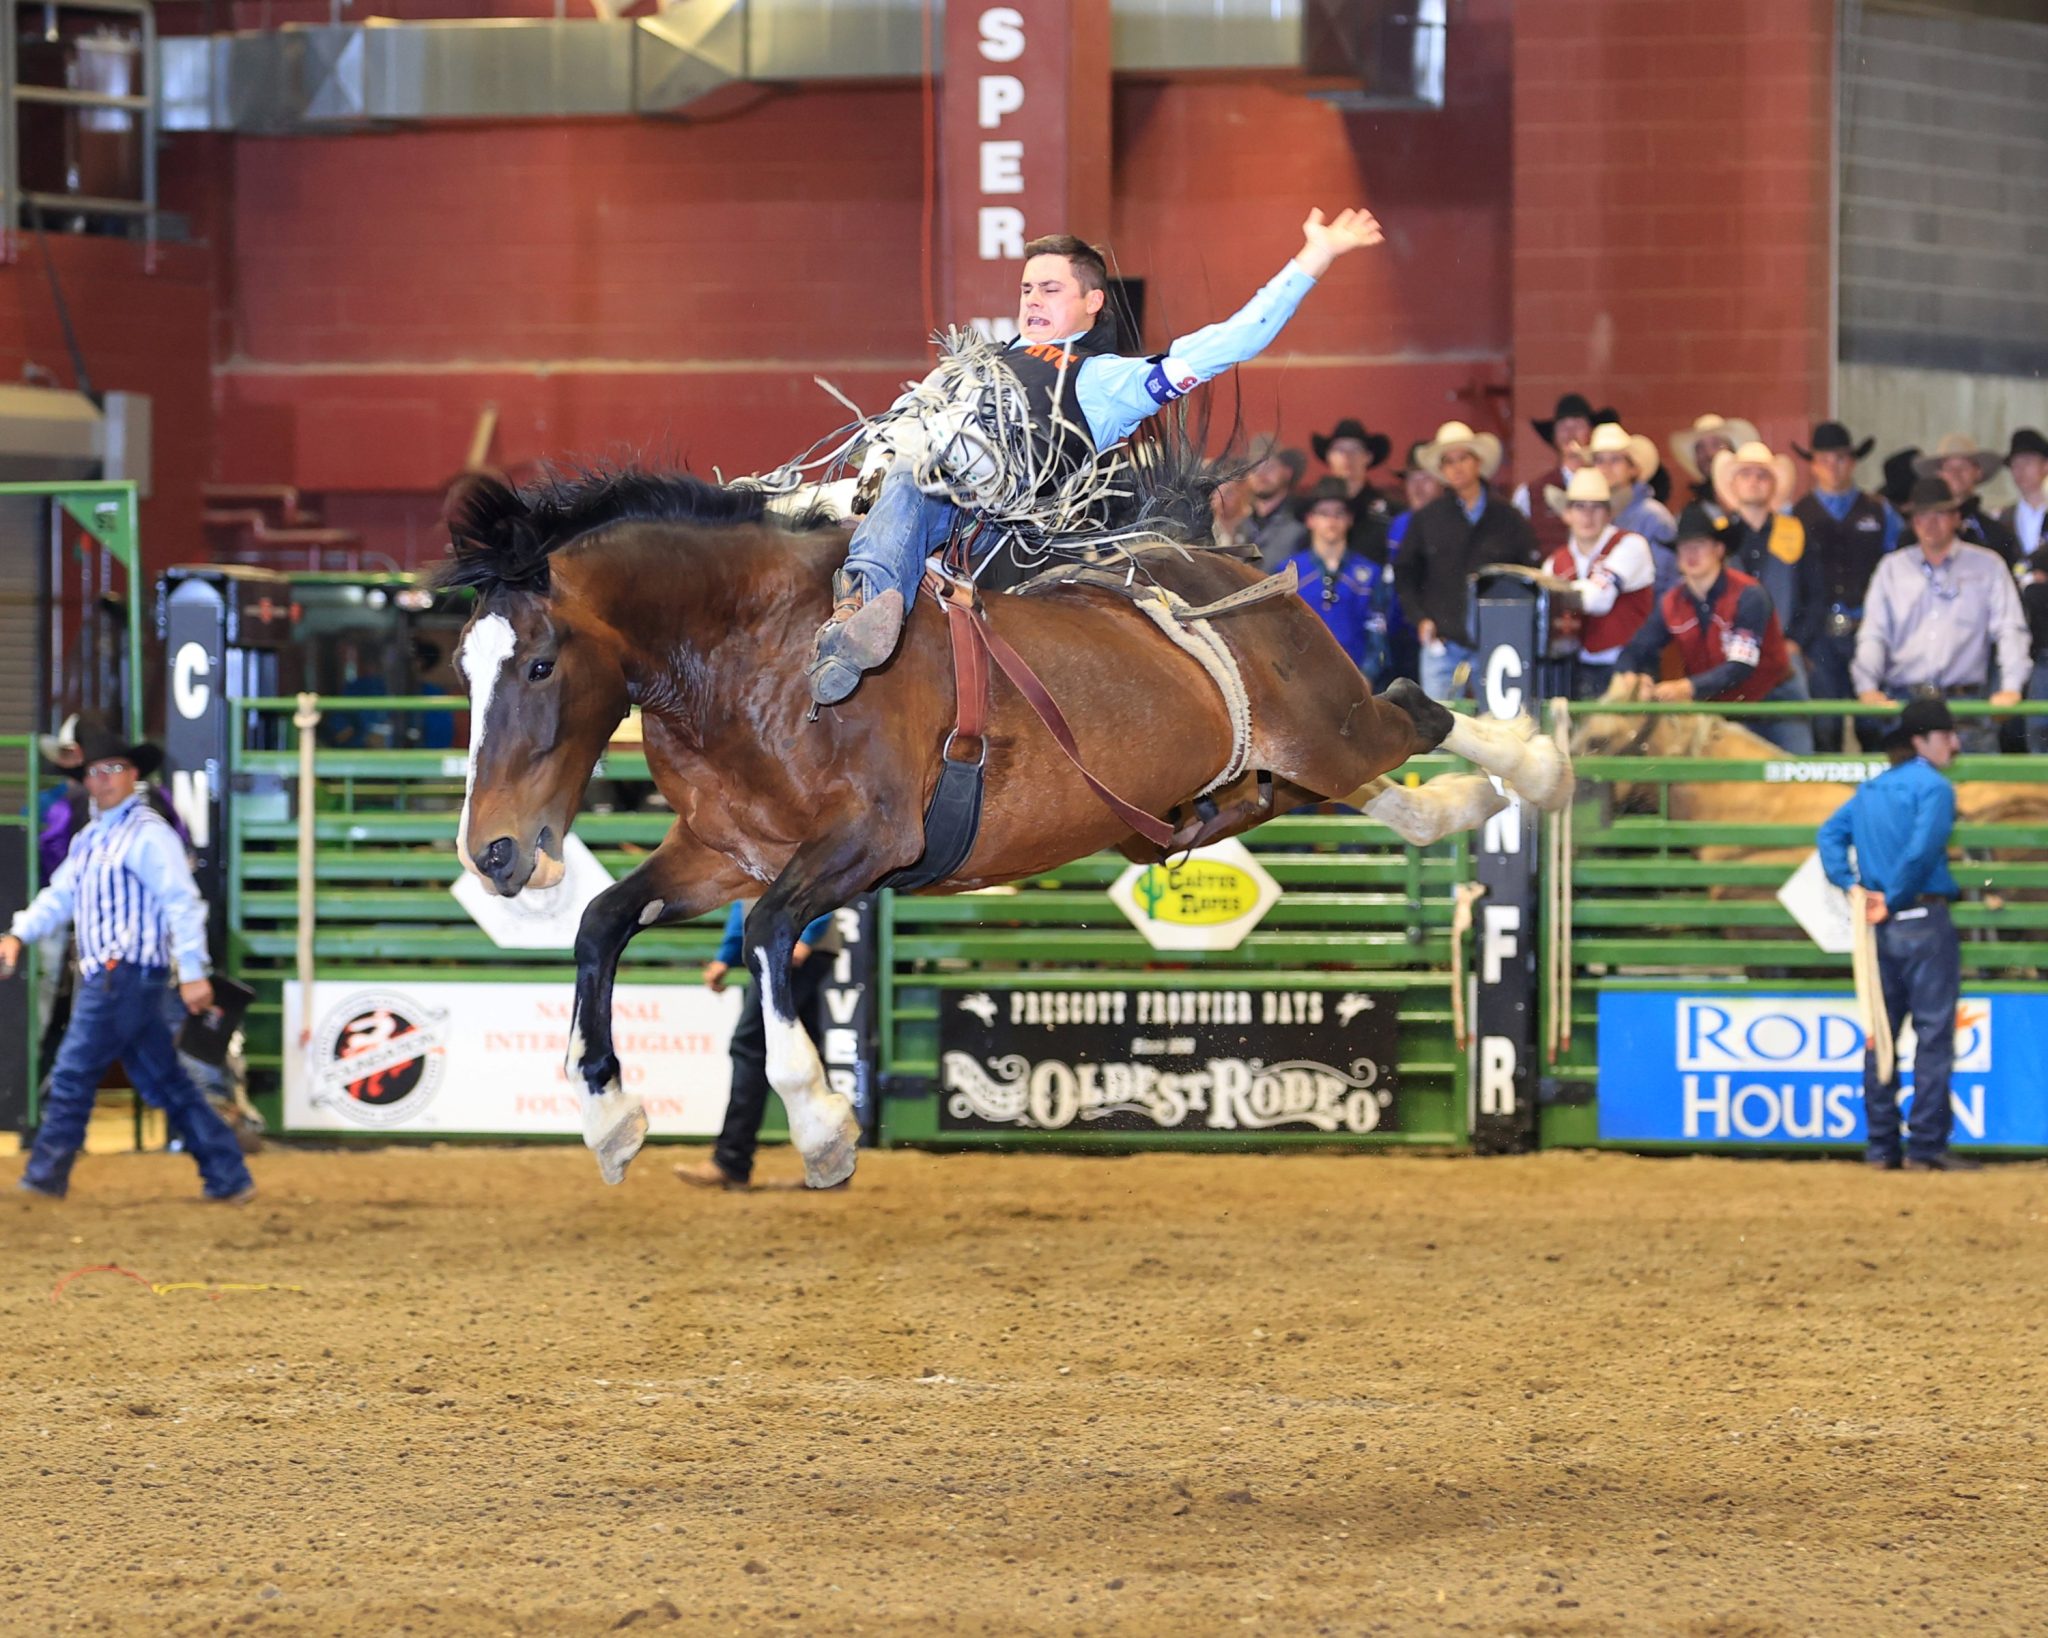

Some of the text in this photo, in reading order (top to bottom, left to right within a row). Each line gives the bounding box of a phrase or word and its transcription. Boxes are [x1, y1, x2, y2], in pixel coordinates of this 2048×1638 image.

[173, 641, 210, 848] CN
[536, 1001, 660, 1020] NANAL
[1010, 991, 1324, 1025] PRESCOTT FRONTIER DAYS
